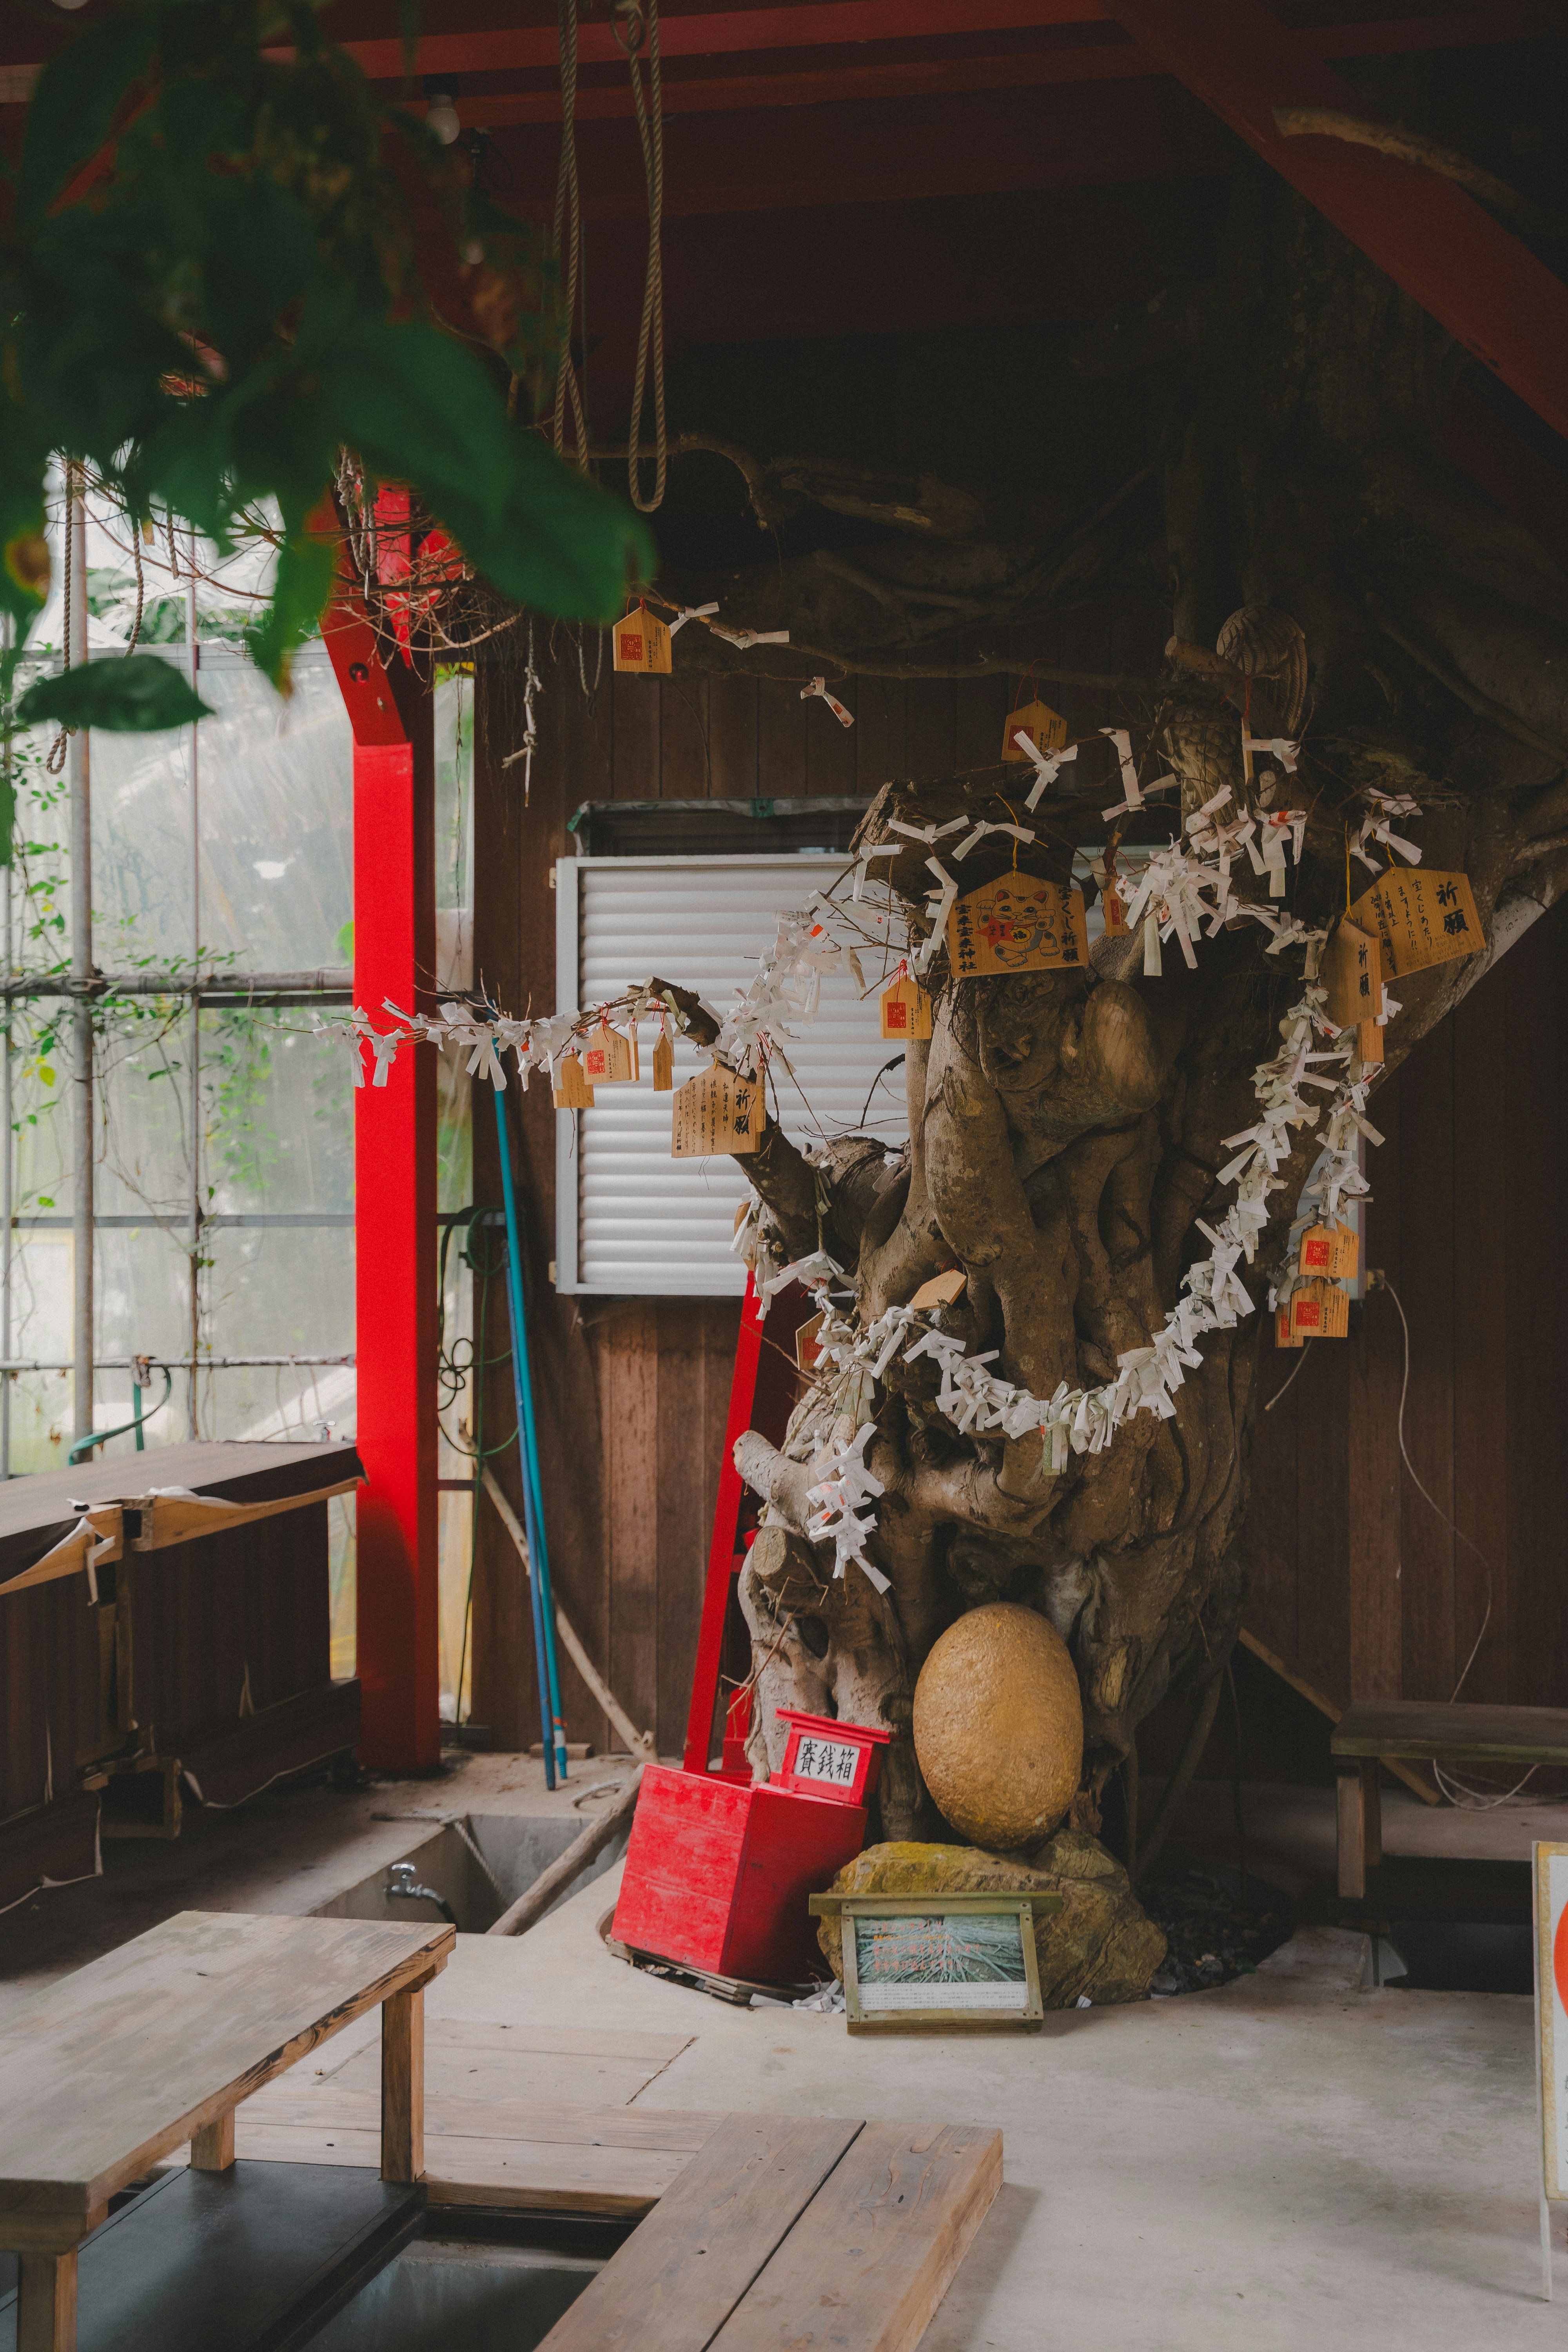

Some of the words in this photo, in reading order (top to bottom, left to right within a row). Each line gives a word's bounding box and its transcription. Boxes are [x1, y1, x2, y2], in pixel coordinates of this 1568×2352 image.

[1013, 930, 1027, 940] 福
[1058, 887, 1079, 962] 宝くじ祈願
[1412, 879, 1433, 947] 宝くじあたり
[1436, 881, 1469, 935] 祈願
[955, 904, 977, 972] 宝来宝来神社
[1359, 942, 1370, 998] 祈願
[733, 1088, 751, 1135] 祈願
[800, 1740, 855, 1780] 賽銭箱
